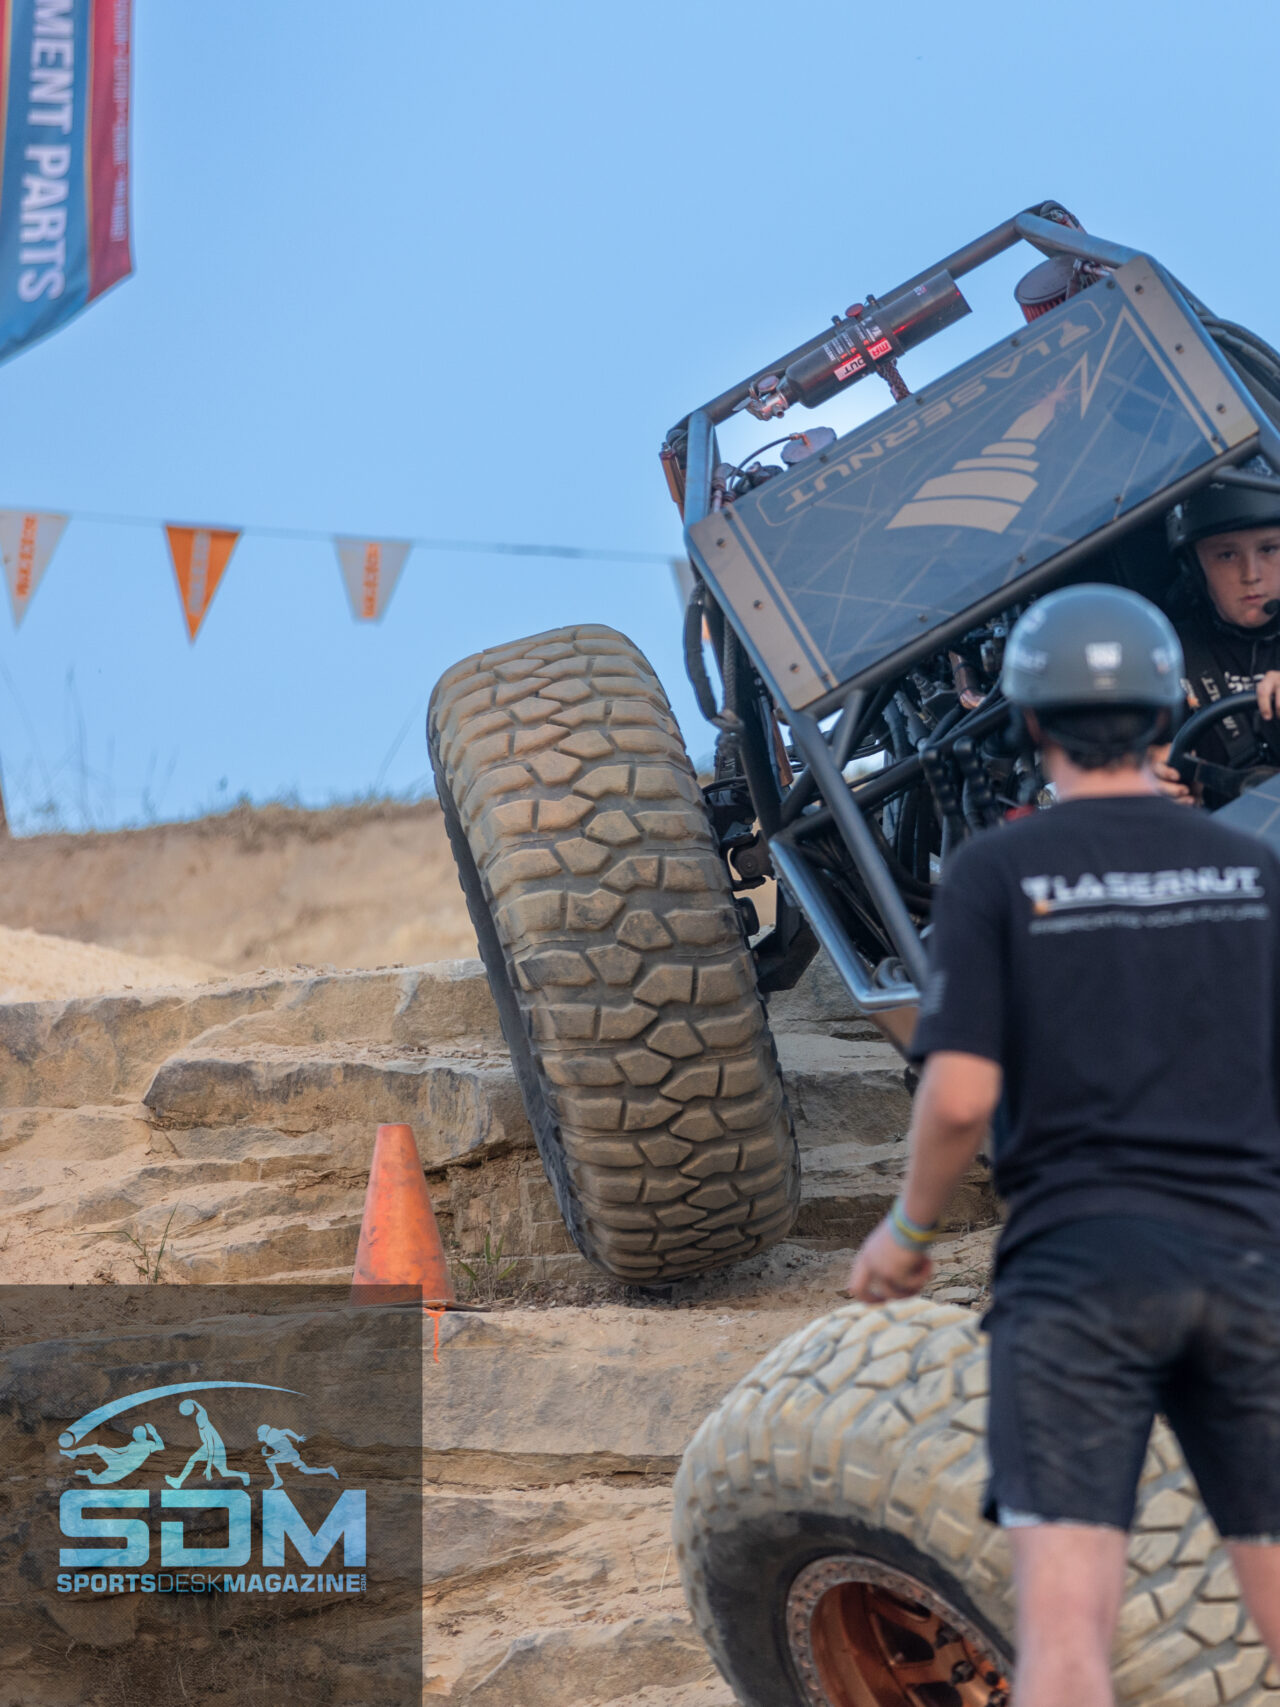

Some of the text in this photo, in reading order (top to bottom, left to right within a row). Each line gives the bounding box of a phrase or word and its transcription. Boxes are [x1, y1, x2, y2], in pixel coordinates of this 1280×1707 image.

[18, 145, 71, 302] PARTS
[784, 340, 1050, 513] LASERNUT
[1053, 866, 1261, 901] LASERNUT
